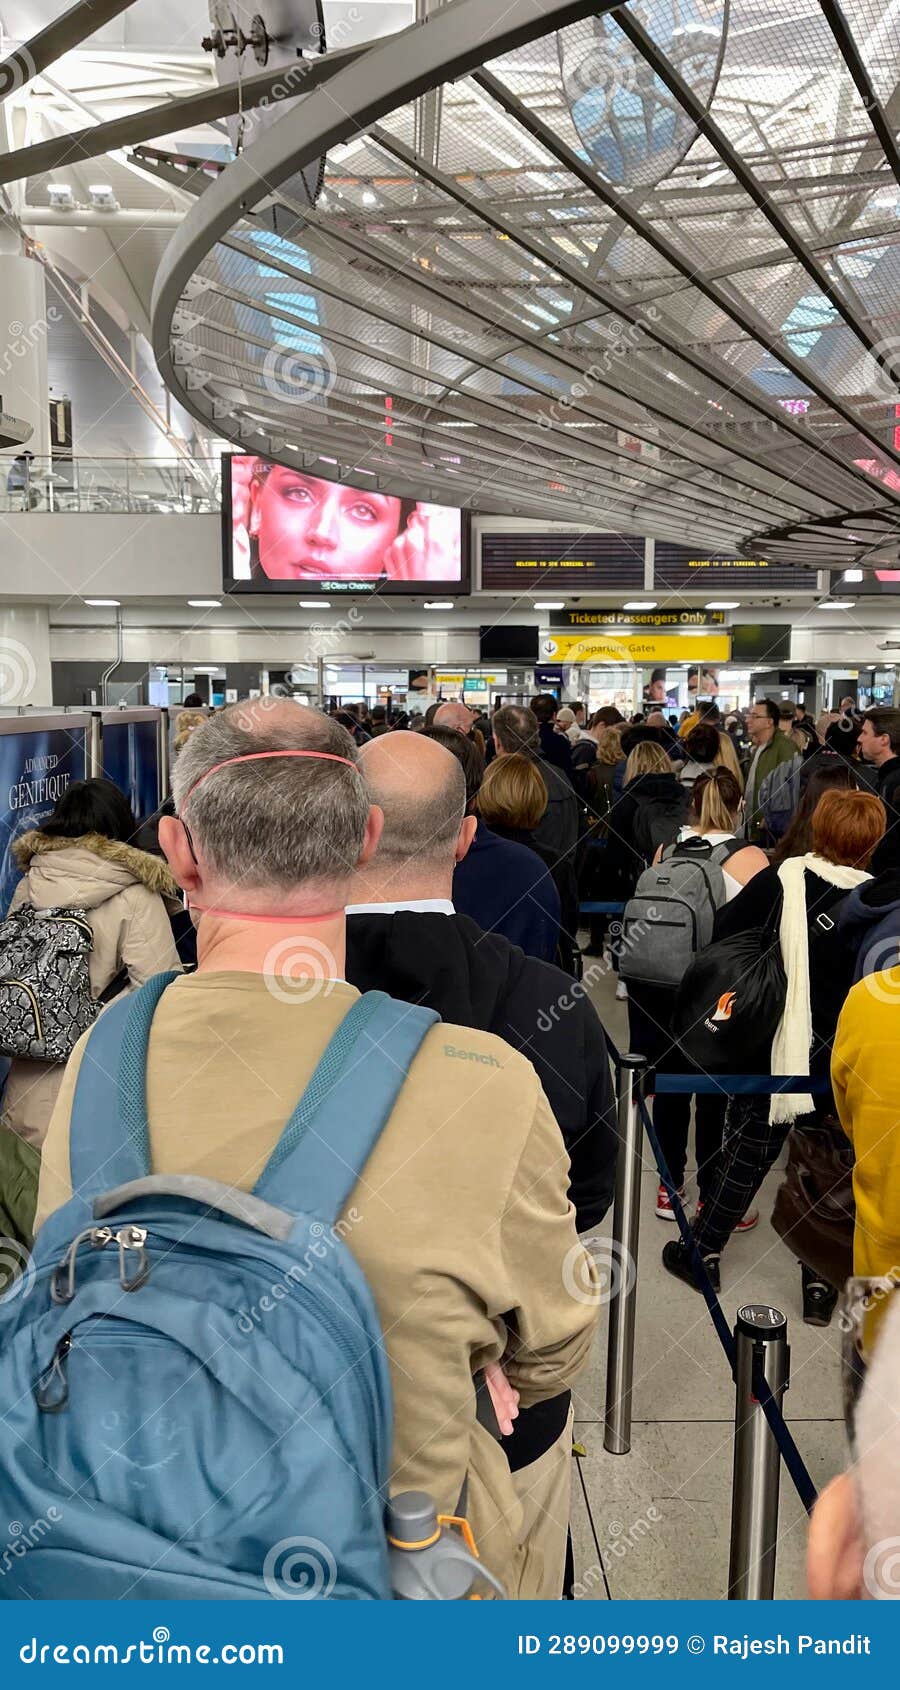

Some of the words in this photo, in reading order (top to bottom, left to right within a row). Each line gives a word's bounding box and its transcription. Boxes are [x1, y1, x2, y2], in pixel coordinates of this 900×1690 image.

[569, 613, 616, 624] Ticketed
[617, 613, 677, 626] Passengers
[680, 611, 707, 625] Only
[578, 643, 625, 653] Departure
[629, 643, 656, 653] Gates
[24, 755, 59, 774] ADVANCED
